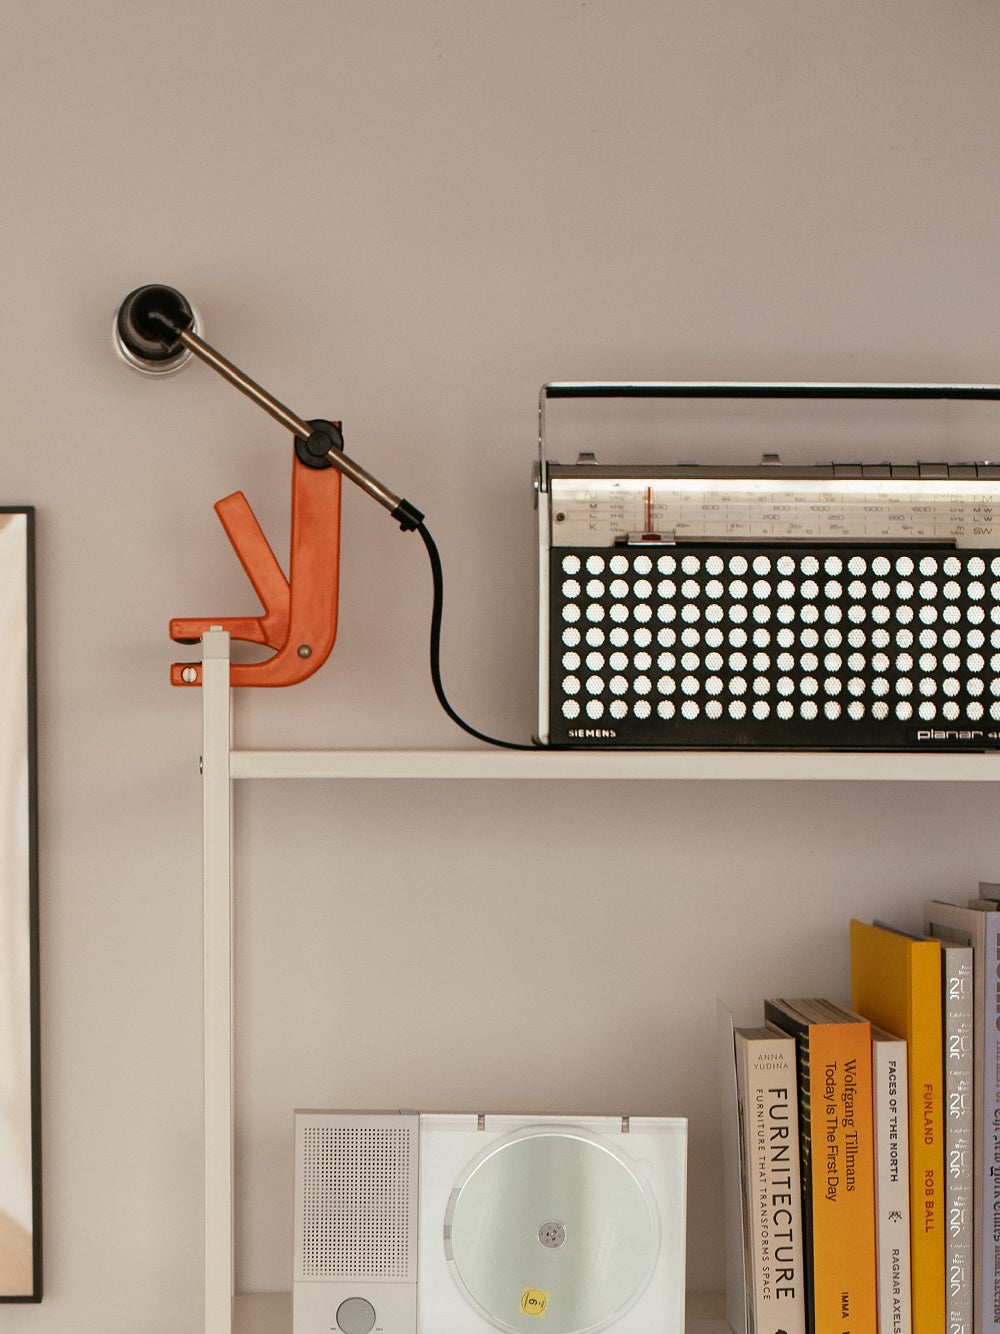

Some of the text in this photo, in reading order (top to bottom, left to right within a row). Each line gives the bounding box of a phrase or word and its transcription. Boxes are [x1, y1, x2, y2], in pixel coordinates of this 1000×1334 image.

[568, 729, 616, 737] SIEMENS
[917, 728, 983, 740] planar
[753, 1062, 789, 1071] YUDINA
[758, 1053, 784, 1061] ANNA
[825, 1062, 839, 1202] Today Is The First Day
[843, 1058, 858, 1192] Wolfgang Tillmans
[888, 1060, 899, 1183] FACES OF THE NORTH
[923, 1083, 933, 1145] FUNLAND
[756, 1089, 771, 1301] FURNITURE THAT TRANSFORMS SPACE
[768, 1088, 795, 1300] FURNITECTURE
[924, 1170, 934, 1233] ROB BALL
[892, 1249, 900, 1294] RAGNAR
